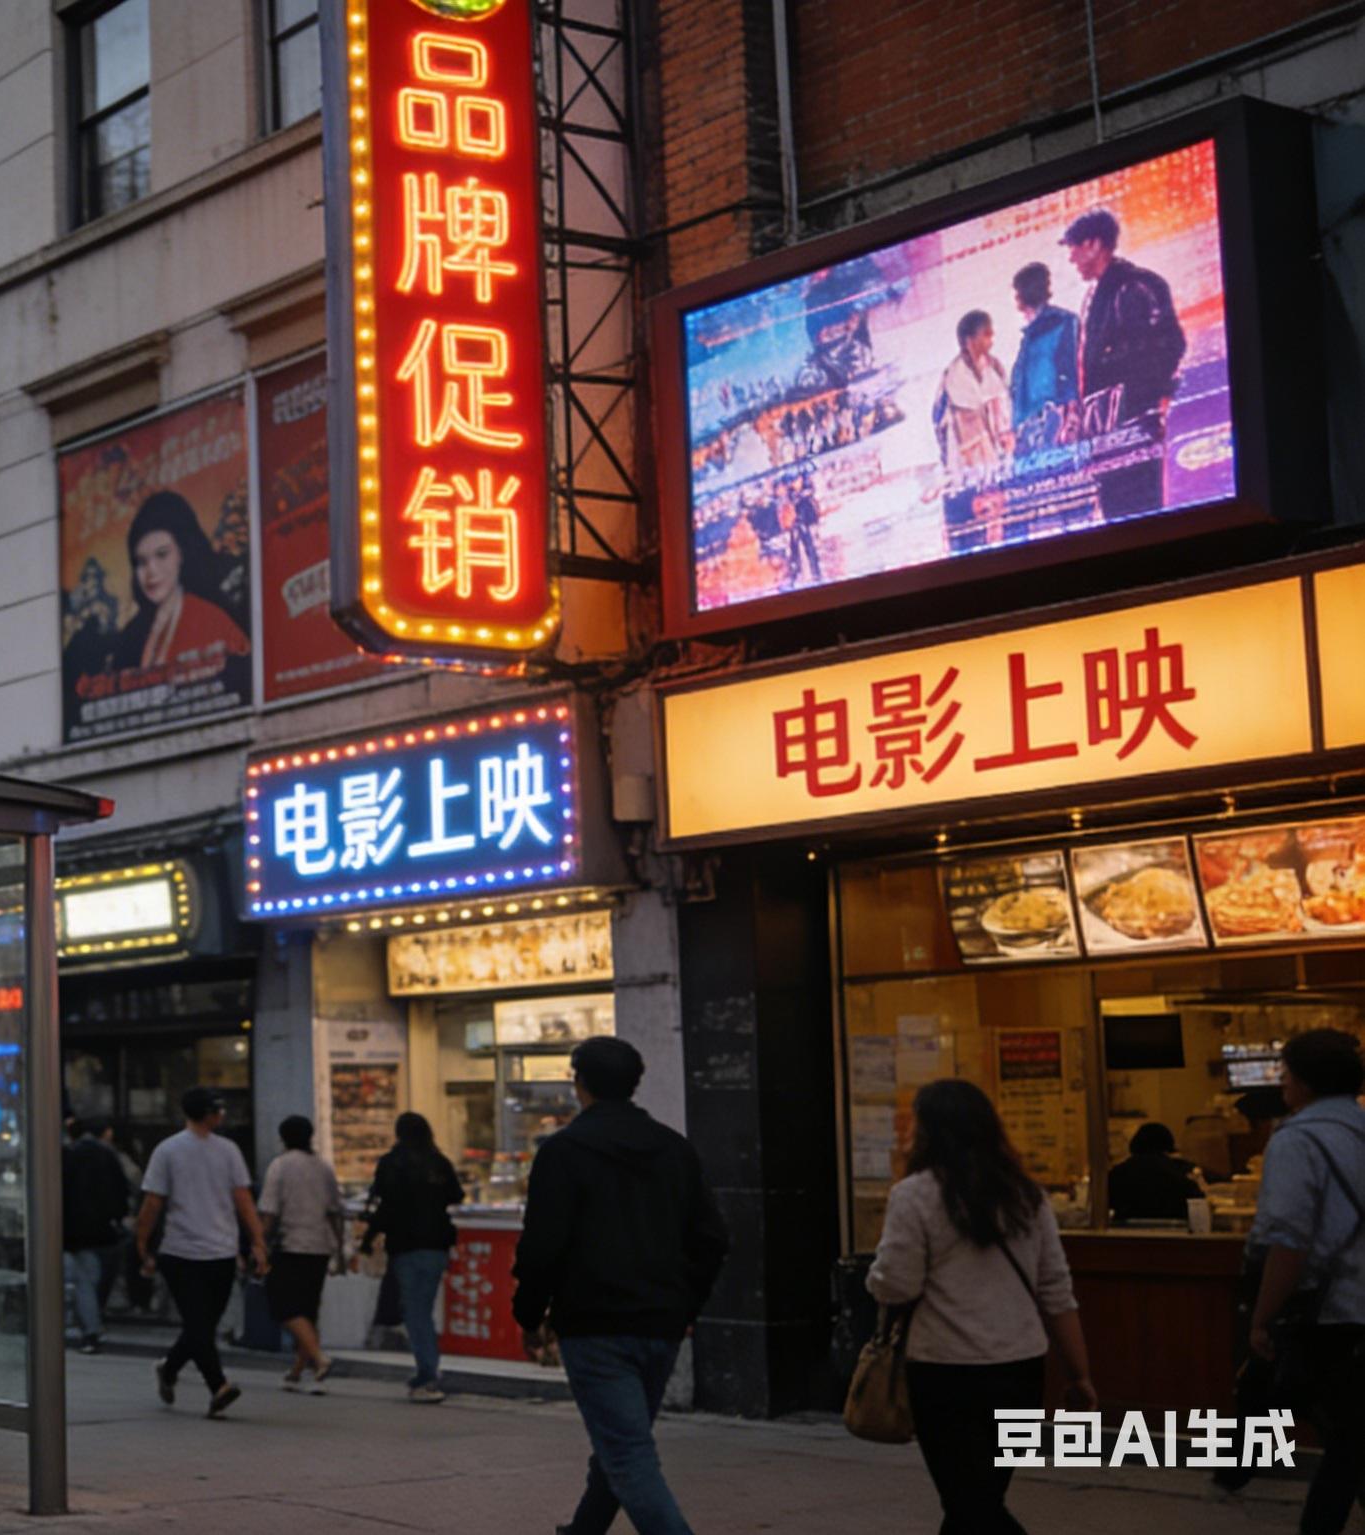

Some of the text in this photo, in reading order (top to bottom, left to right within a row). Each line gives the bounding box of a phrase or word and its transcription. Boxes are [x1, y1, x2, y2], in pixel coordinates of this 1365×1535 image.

[397, 32, 524, 601] 品牌促销
[772, 627, 1198, 798] 电影上映
[273, 743, 553, 877] 电影上映
